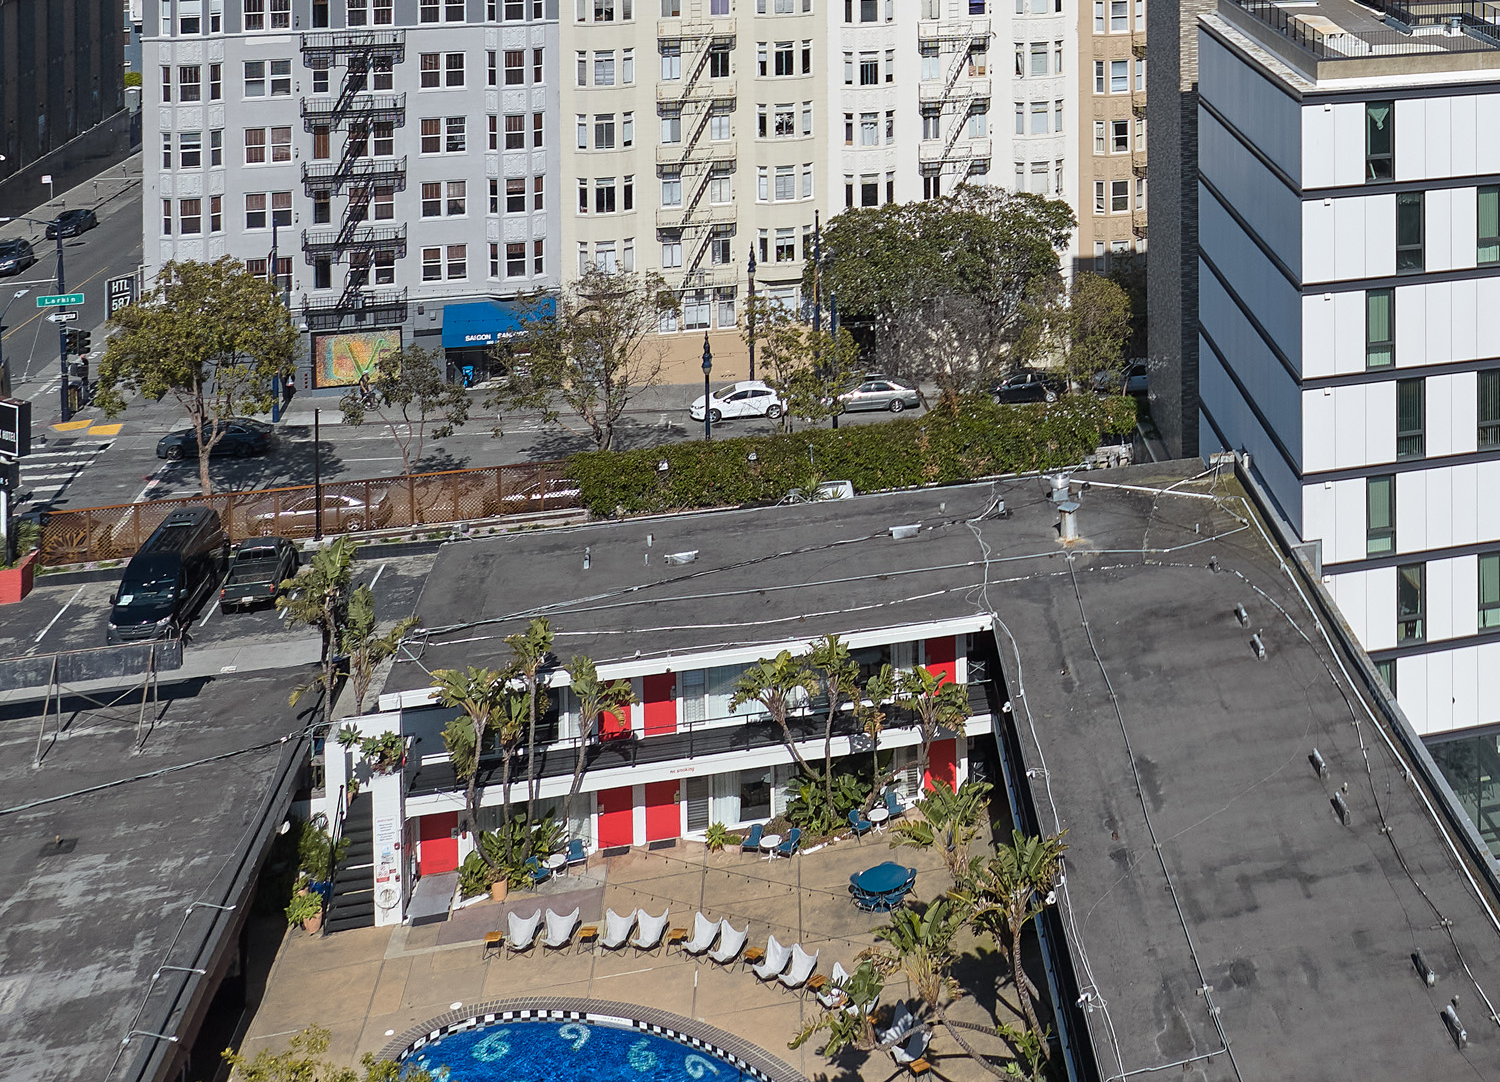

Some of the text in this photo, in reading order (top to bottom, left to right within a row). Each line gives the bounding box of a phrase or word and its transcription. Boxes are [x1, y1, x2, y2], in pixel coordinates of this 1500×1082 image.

[112, 279, 130, 293] HTL
[45, 297, 76, 305] Larkin
[112, 296, 131, 311] 587
[464, 334, 492, 342] SAIGON
